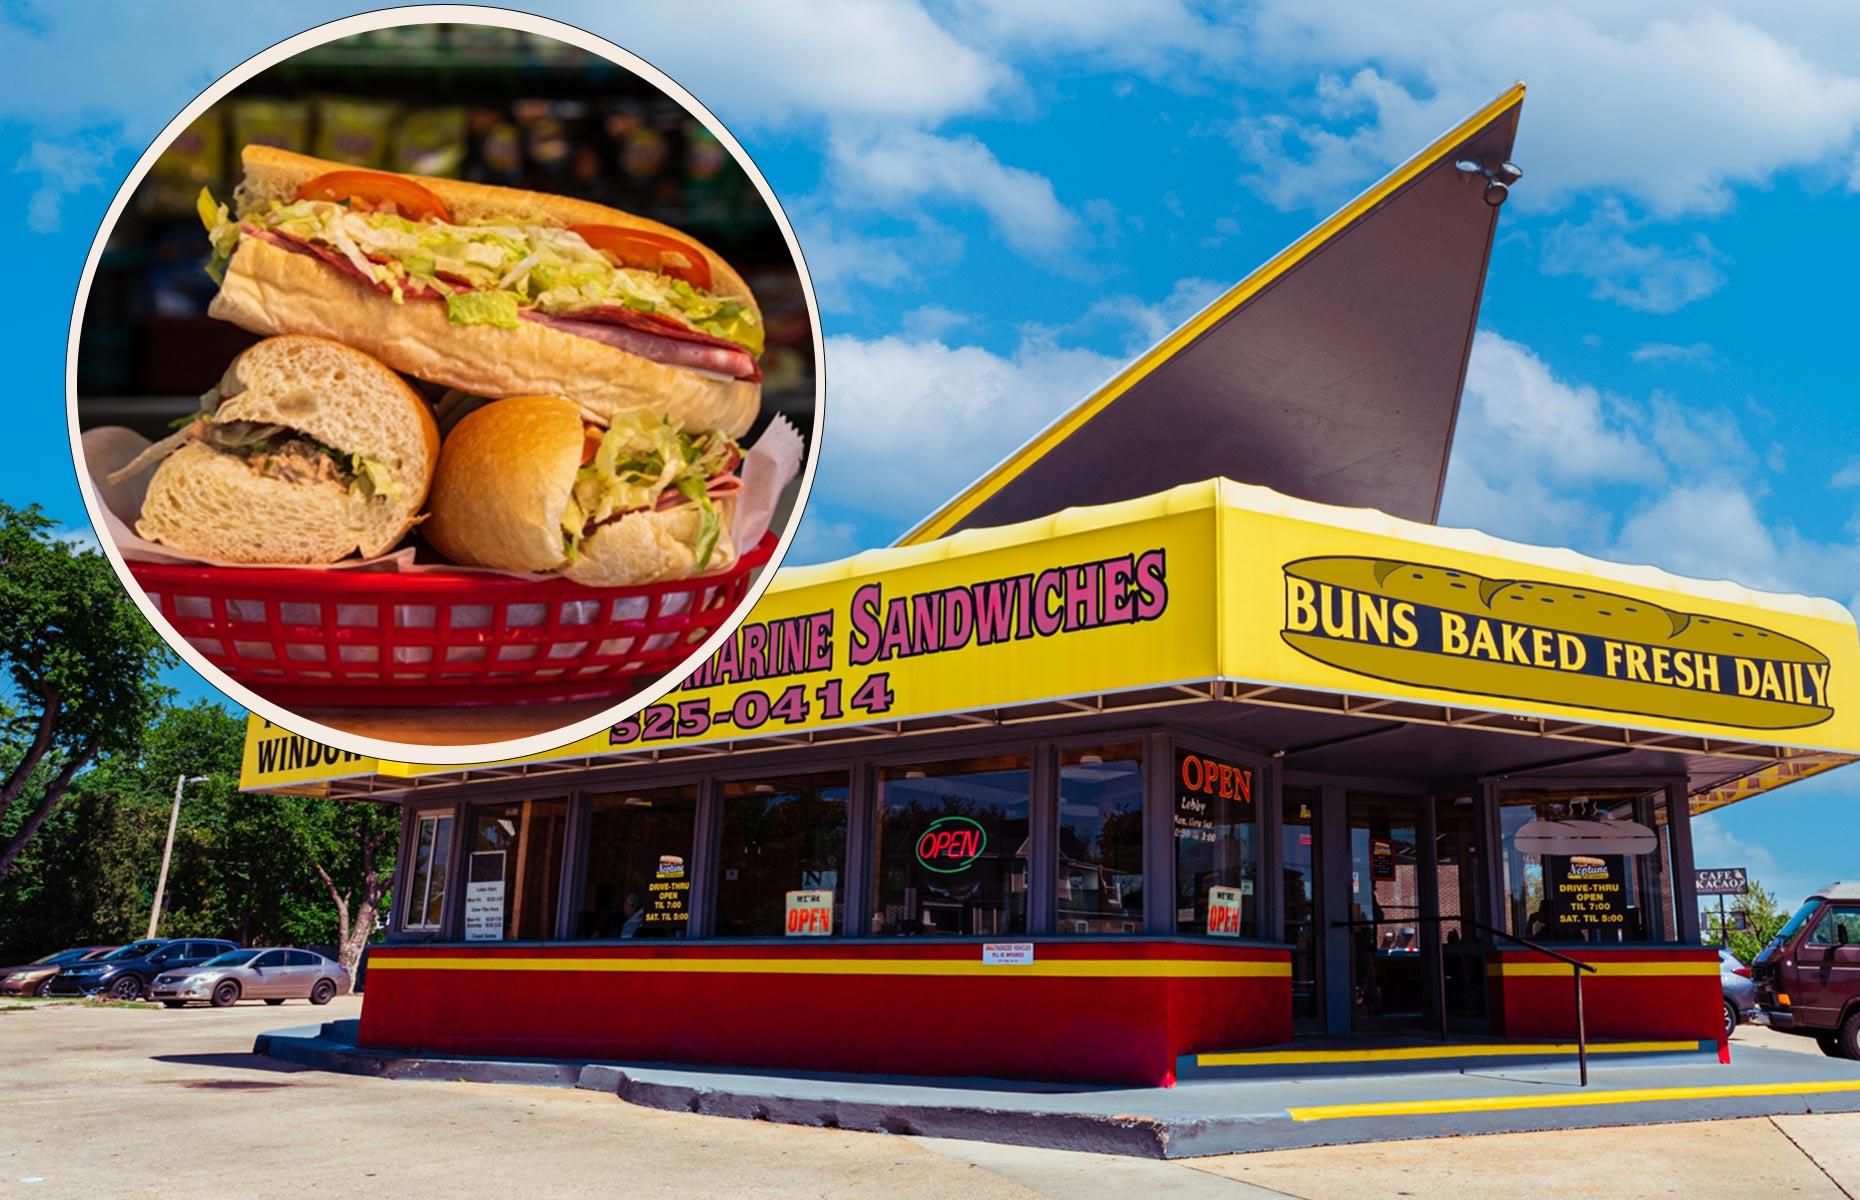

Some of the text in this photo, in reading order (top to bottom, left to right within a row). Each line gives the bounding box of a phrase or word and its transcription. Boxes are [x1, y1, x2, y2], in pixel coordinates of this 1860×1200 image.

[671, 548, 1169, 692] ARINE SANDWICHES
[1286, 576, 1829, 707] BUNS BAKED FRESH DAILY
[609, 672, 895, 746] 525-0414
[1182, 755, 1252, 804] OPEN
[1181, 796, 1206, 816] Lobby
[919, 829, 980, 860] OPEN
[1568, 863, 1608, 877] Neptune
[1699, 871, 1733, 880] CAFE
[649, 882, 690, 892] DRIVE-THRU
[1559, 884, 1620, 893] DRIVE-THRU
[1695, 879, 1738, 889] KACAO
[659, 892, 678, 900] OPEN
[1576, 893, 1604, 901] OPEN
[654, 901, 682, 910] TIL 7:00
[1570, 903, 1611, 911] TIL 7:00
[645, 913, 660, 922] SAT.
[661, 912, 672, 921] TIL
[788, 907, 831, 934] OPEN
[1208, 905, 1240, 933] OPEN
[1559, 914, 1624, 923] SAT. TIL 5:00
